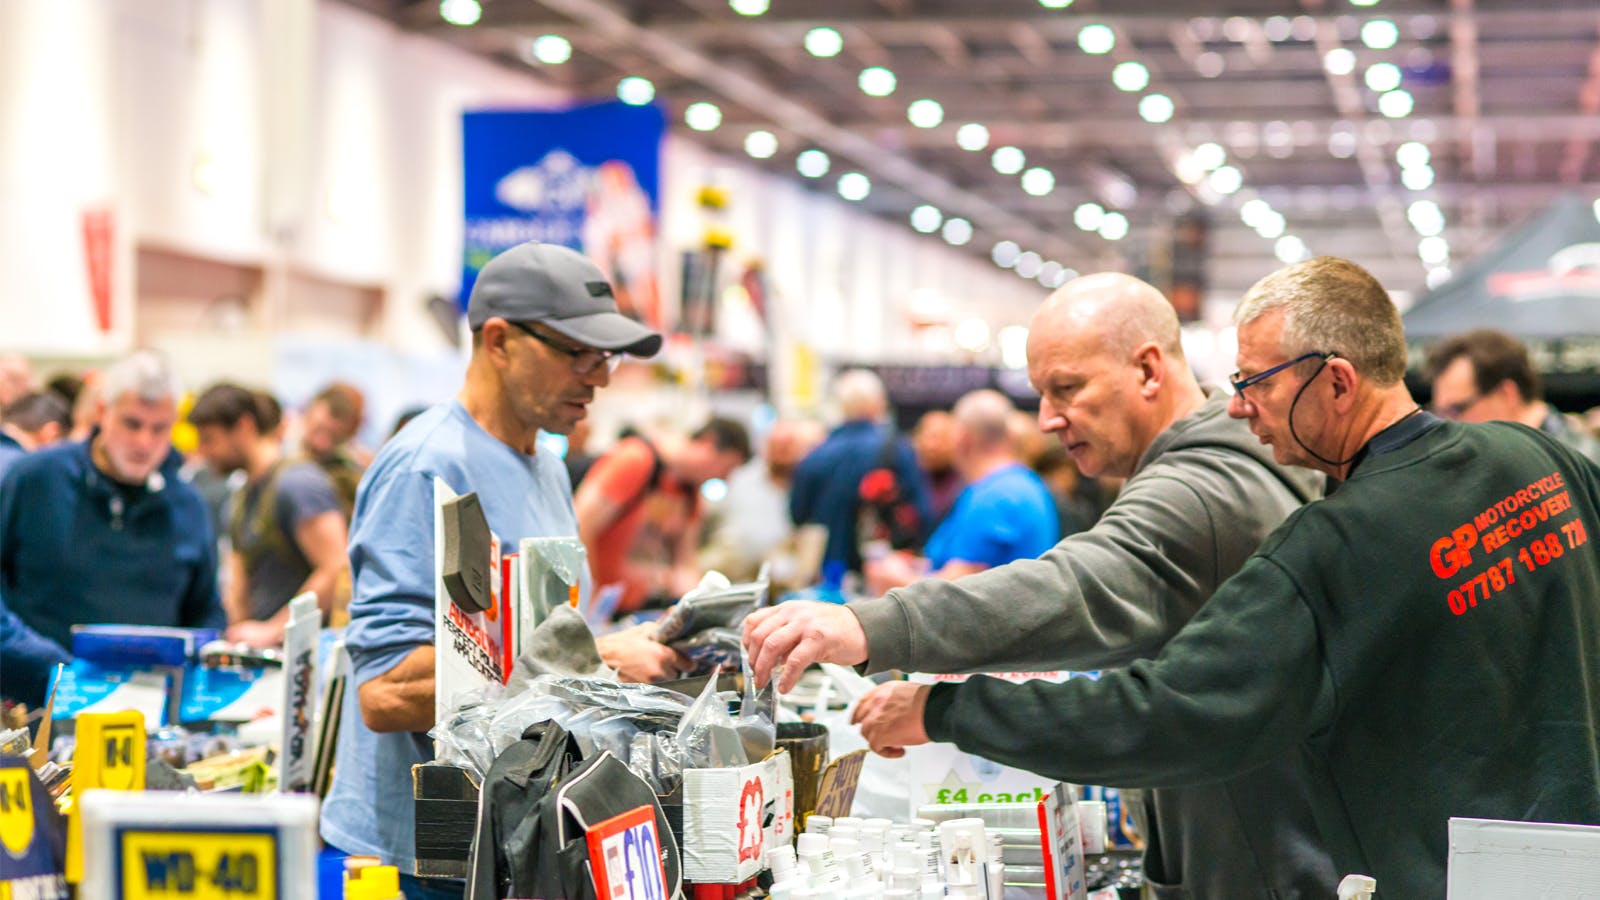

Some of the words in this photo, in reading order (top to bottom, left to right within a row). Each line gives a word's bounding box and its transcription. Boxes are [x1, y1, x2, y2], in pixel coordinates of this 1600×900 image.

[1474, 472, 1565, 532] MOTORCYCLE
[1481, 490, 1572, 553] RECOVERY
[1430, 523, 1478, 579] GP
[1447, 557, 1515, 615] 07787
[1518, 533, 1564, 573] 188
[737, 776, 764, 864] £3
[936, 788, 969, 804] £4
[140, 850, 258, 893] WD-40
[623, 825, 663, 900] £10
